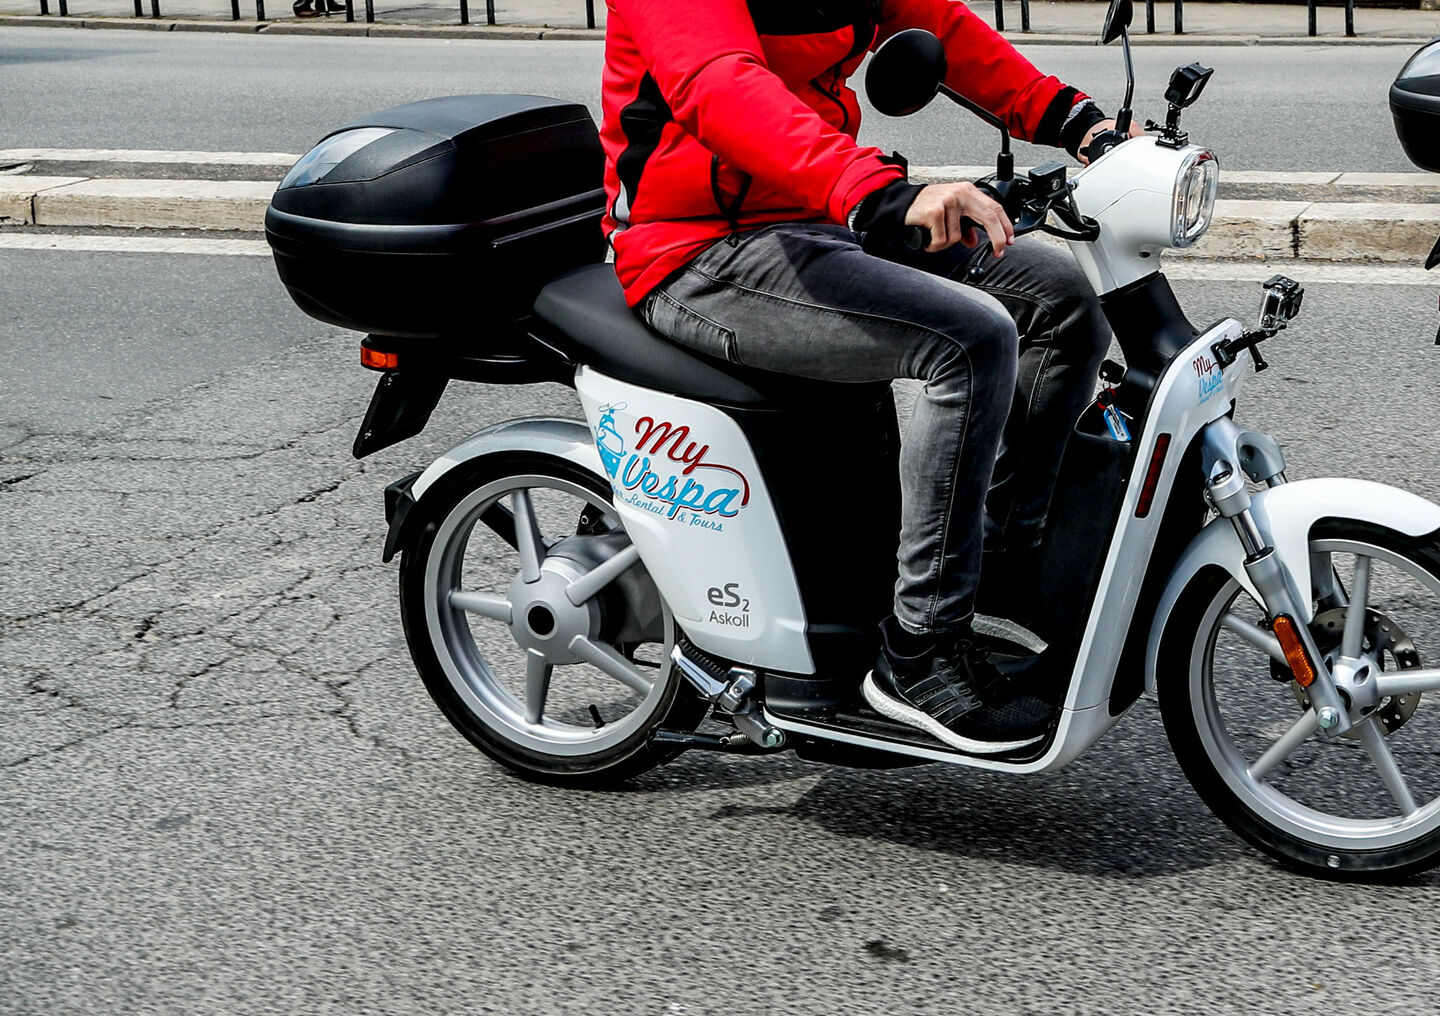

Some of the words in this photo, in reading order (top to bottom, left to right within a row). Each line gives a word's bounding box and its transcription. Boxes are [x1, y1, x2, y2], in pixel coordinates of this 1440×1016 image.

[1193, 355, 1219, 378] My
[622, 454, 741, 520] Vespa
[625, 494, 665, 516] Rental
[677, 511, 687, 523] &
[689, 513, 724, 532] Tours
[709, 610, 750, 628] Askoll
